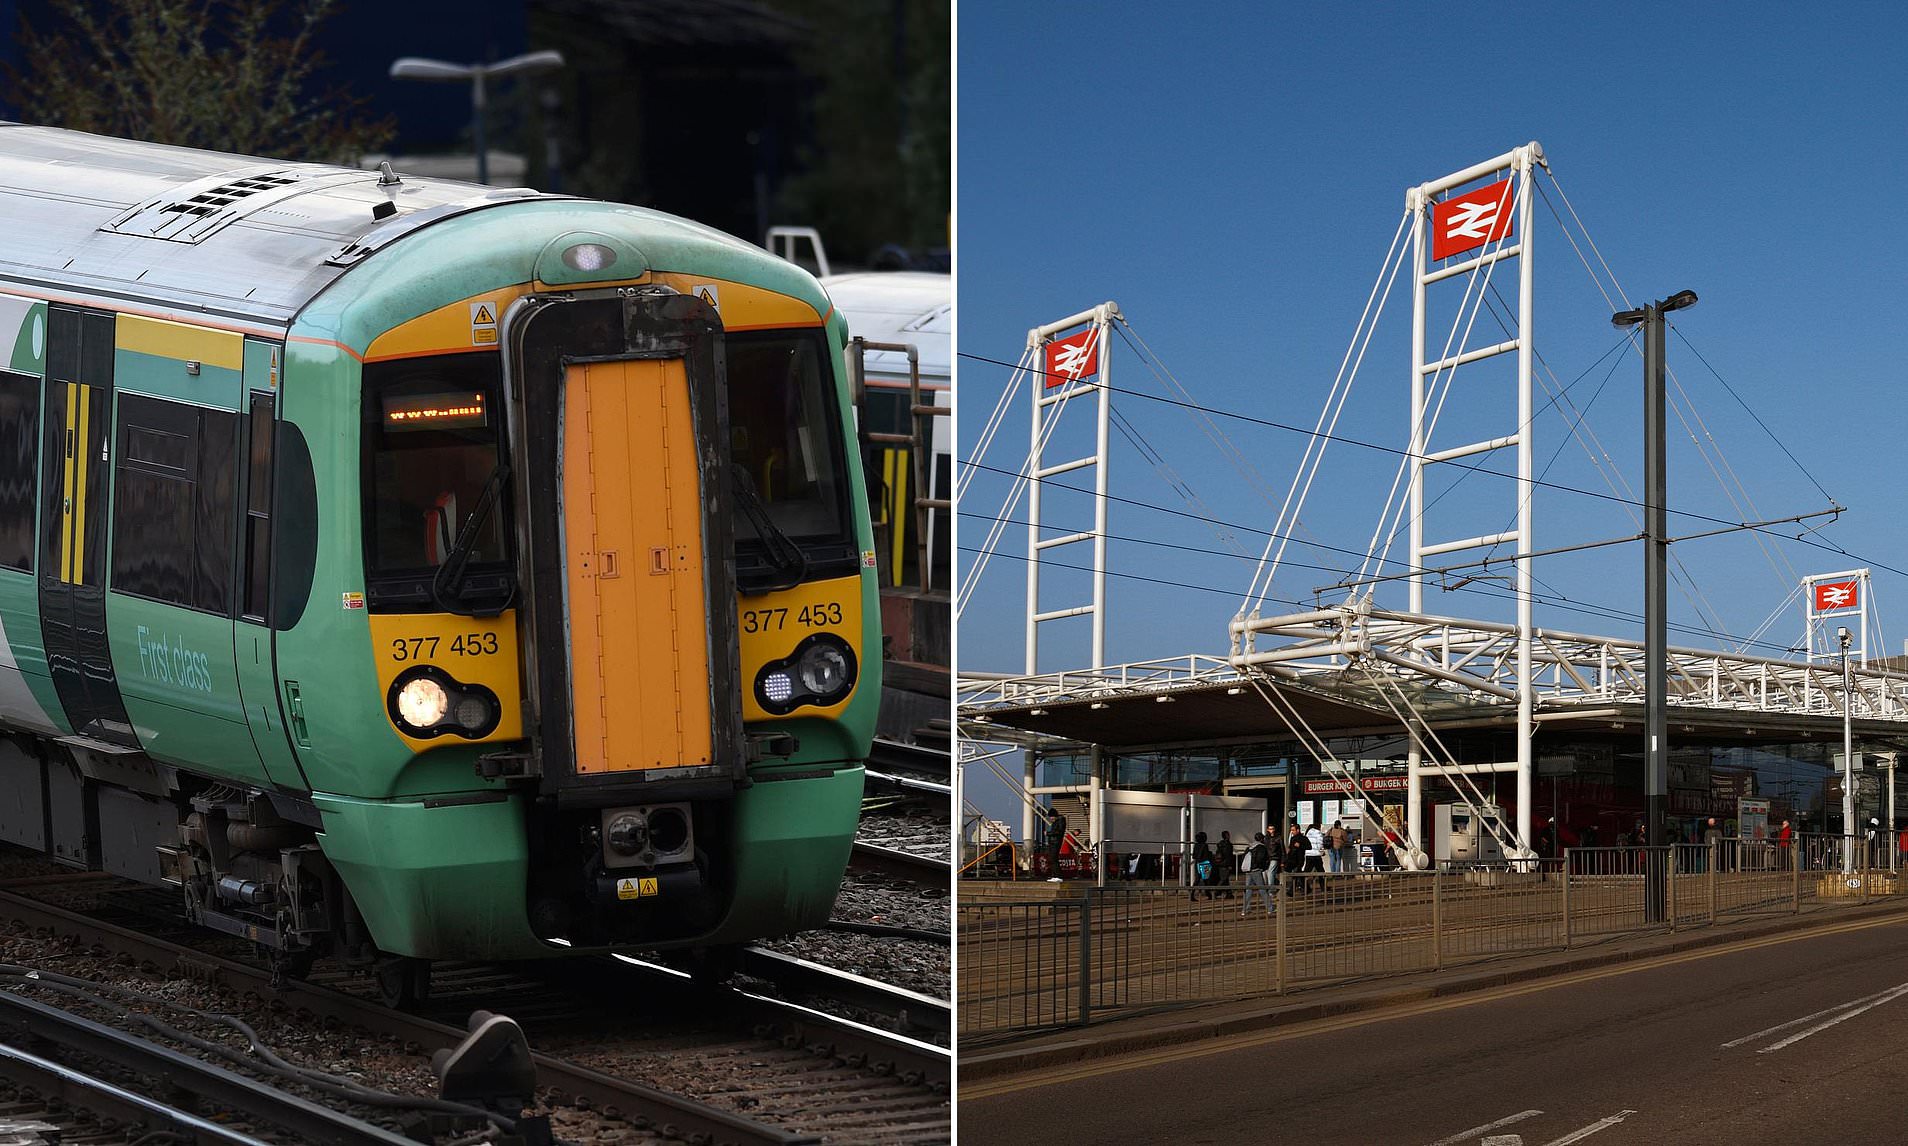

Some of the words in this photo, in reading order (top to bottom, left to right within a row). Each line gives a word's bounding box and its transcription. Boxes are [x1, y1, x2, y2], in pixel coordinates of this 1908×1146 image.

[742, 608, 789, 634] 377
[797, 602, 843, 628] 453
[137, 625, 174, 684] First
[173, 634, 212, 693] class
[392, 636, 441, 662] 377
[450, 632, 499, 657] 453
[1308, 782, 1334, 791] BURGER
[1373, 779, 1401, 789] BURGER
